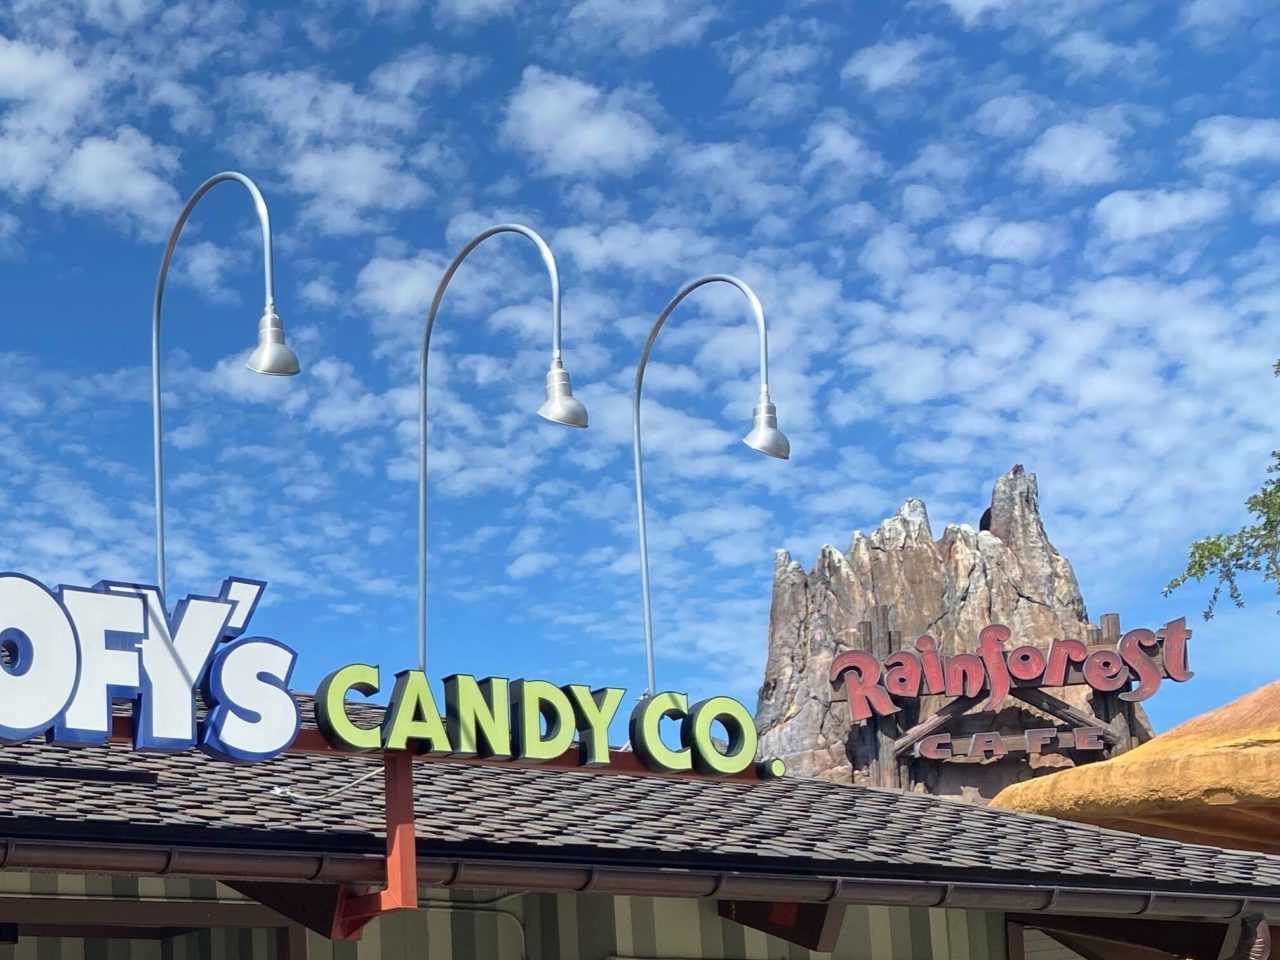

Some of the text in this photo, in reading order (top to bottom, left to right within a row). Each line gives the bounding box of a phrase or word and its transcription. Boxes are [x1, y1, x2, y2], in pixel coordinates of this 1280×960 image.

[314, 662, 627, 769] CANDY
[629, 690, 787, 778] CO.
[829, 616, 1195, 721] Rainforest
[918, 727, 1105, 760] CAFE
